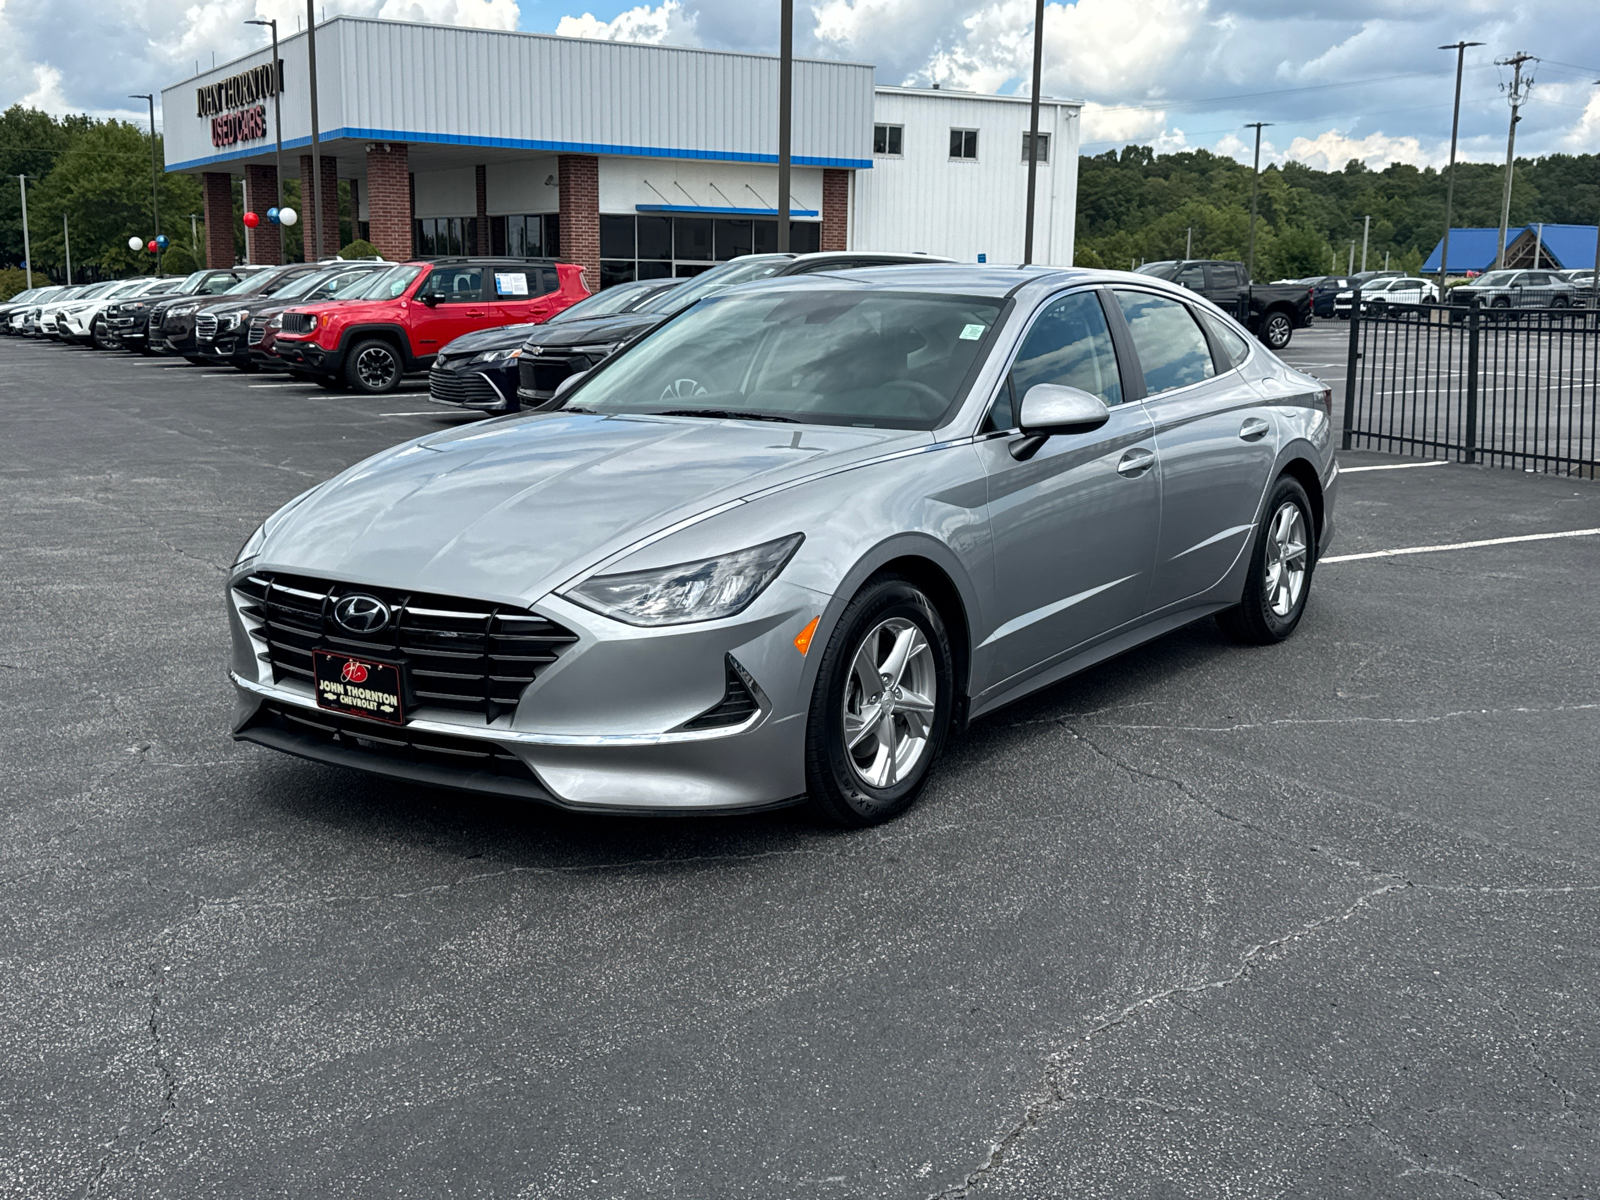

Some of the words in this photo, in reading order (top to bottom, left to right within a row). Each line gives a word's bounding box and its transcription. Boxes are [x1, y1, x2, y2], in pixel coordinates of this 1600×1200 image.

[196, 82, 223, 118] JOHN
[211, 113, 235, 147] USED
[236, 105, 267, 141] CARS
[319, 679, 345, 694] JOHN
[345, 685, 398, 706] THORNTON
[339, 694, 378, 711] CHEVROLET
